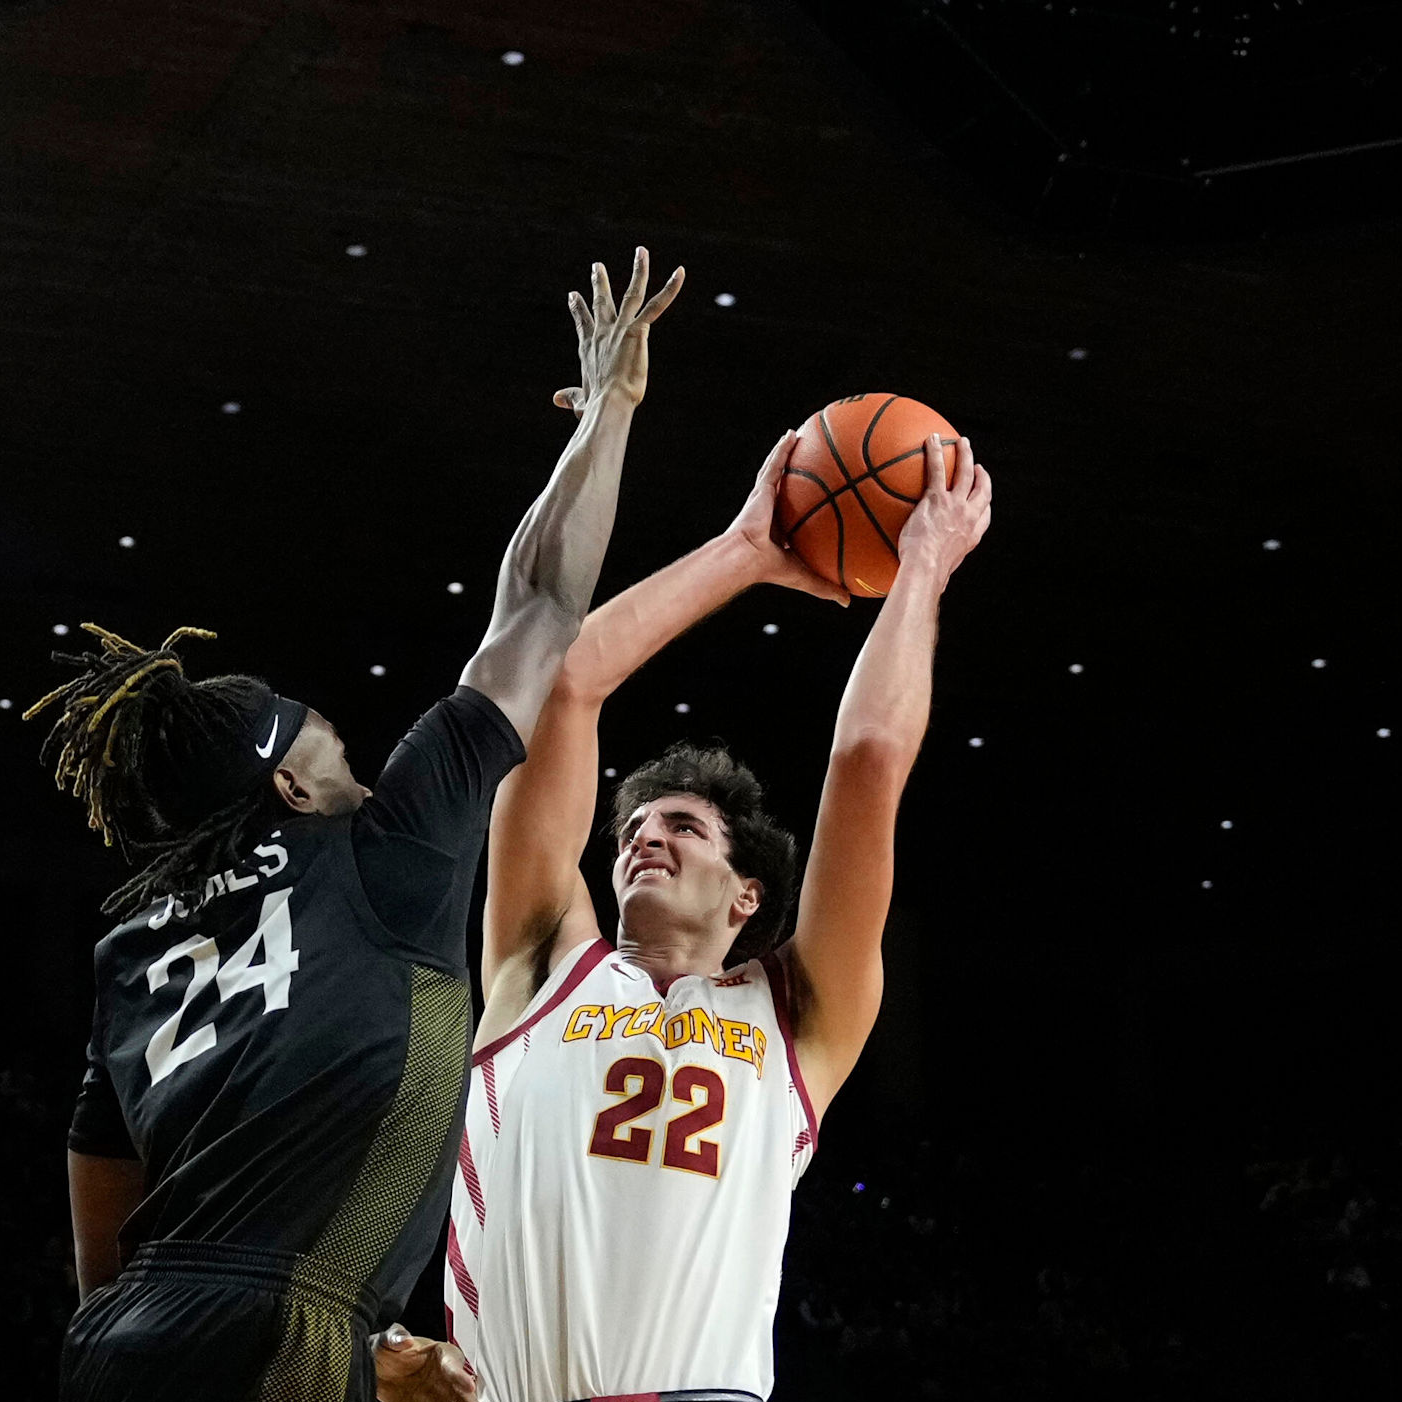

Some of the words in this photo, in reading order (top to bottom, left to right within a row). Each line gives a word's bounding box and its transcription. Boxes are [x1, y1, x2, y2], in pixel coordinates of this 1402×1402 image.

[145, 886, 300, 1087] 24
[562, 1001, 767, 1080] CYCLONES
[587, 1055, 726, 1180] 22
